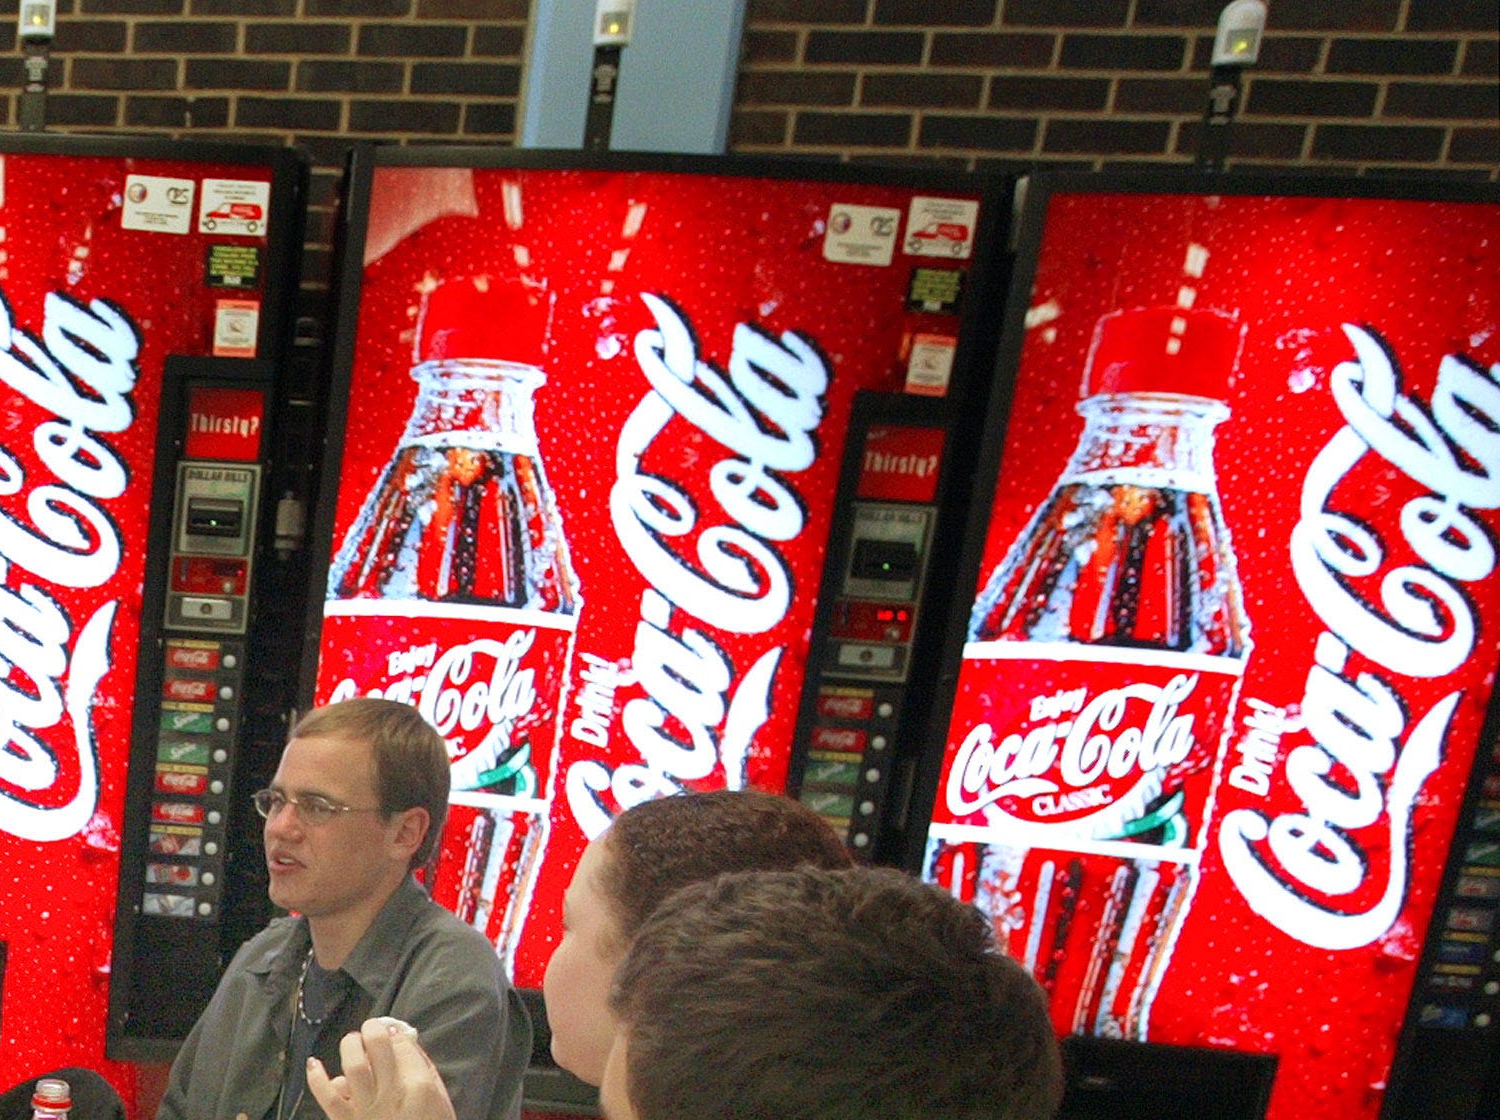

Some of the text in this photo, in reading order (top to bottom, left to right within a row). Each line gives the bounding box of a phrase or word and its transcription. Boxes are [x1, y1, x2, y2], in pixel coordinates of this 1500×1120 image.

[191, 412, 261, 439] Thirsty?
[864, 450, 939, 478] Thirsty?
[566, 291, 833, 842] Coca-Cola
[330, 627, 537, 737] -Cola
[1029, 687, 1088, 722] Enjoy
[946, 672, 1199, 817] Coca-Cola
[1031, 784, 1114, 817] CLASSIC
